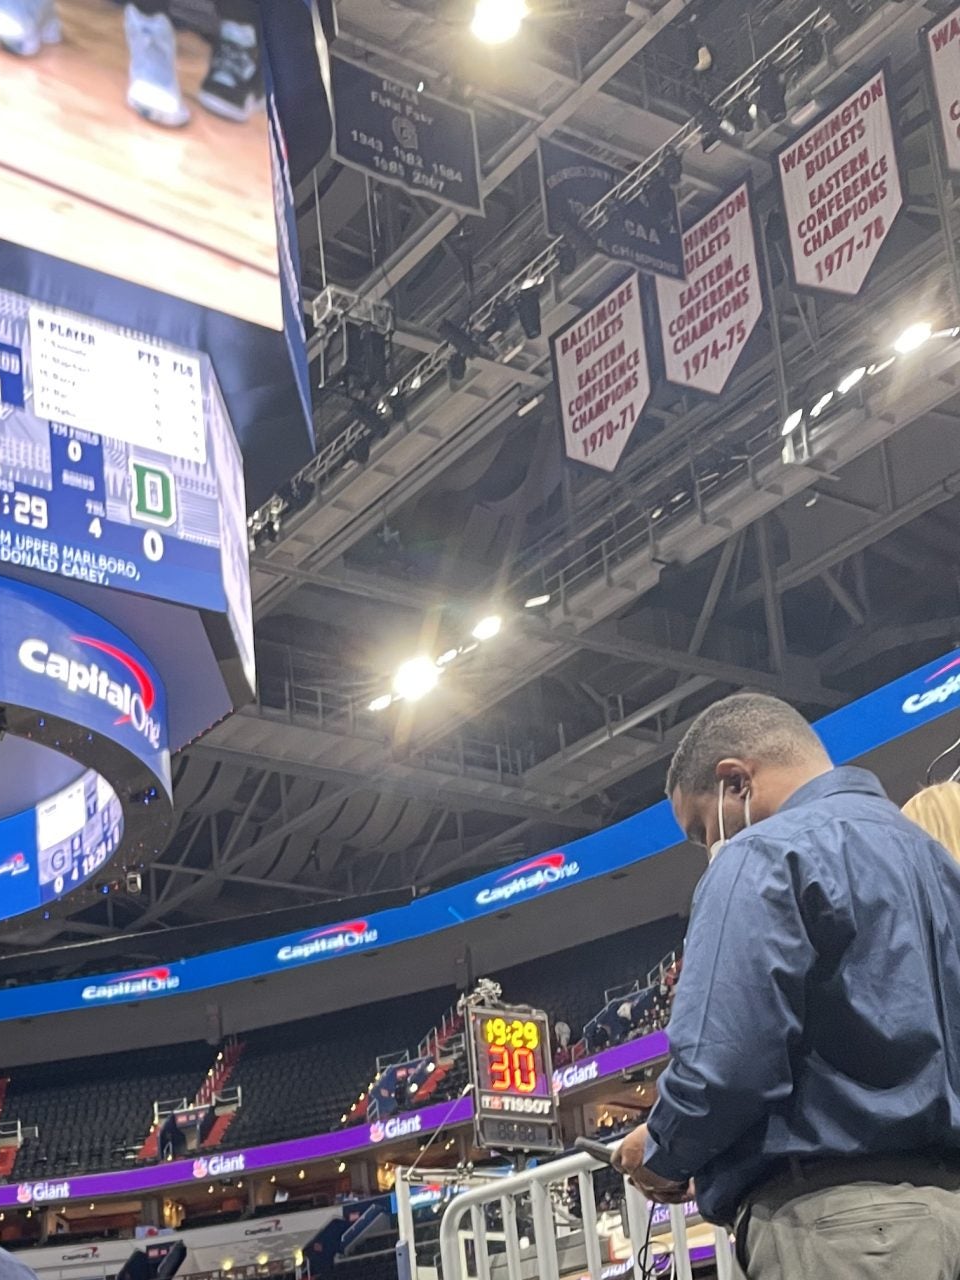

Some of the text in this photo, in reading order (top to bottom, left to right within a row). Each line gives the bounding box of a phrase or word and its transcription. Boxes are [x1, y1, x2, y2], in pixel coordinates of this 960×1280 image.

[781, 79, 884, 174] WASHINGTON
[805, 118, 866, 181] BULLETS
[797, 155, 889, 239] CONFERENCE
[808, 147, 869, 209] EASTERN
[683, 190, 746, 256] HINGTON
[803, 180, 888, 257] CHAMPIONS
[685, 226, 730, 275] ULLETS
[815, 215, 885, 283] 1977-78
[668, 263, 750, 338] CONFERENCE
[679, 255, 733, 309] EASTERN
[50, 322, 96, 345] PLAYER
[138, 350, 160, 367] PTS
[561, 282, 633, 356] BALTIMORE
[576, 313, 624, 365] BULLETS
[673, 287, 749, 355] CHAMPIONS
[577, 340, 625, 391] EASTERN
[683, 319, 746, 381] 1974-75
[568, 348, 640, 417] CONFERENCE
[572, 371, 638, 434] CHAMPIONS
[68, 440, 82, 462] 0
[582, 402, 636, 456] 1970-71
[131, 461, 174, 524] D
[89, 517, 102, 539] 4
[143, 530, 163, 561] 0
[0, 547, 57, 573] DONALD
[16, 534, 57, 558] UPPER
[62, 546, 140, 580] MARLBORO,
[486, 1018, 538, 1050] 19:29
[489, 1045, 536, 1093] 30
[563, 1060, 598, 1088] Giant
[385, 1114, 421, 1138] Giant
[501, 1096, 551, 1115] TISSOT
[32, 1181, 70, 1201] Giant
[208, 1154, 245, 1176] Giant
